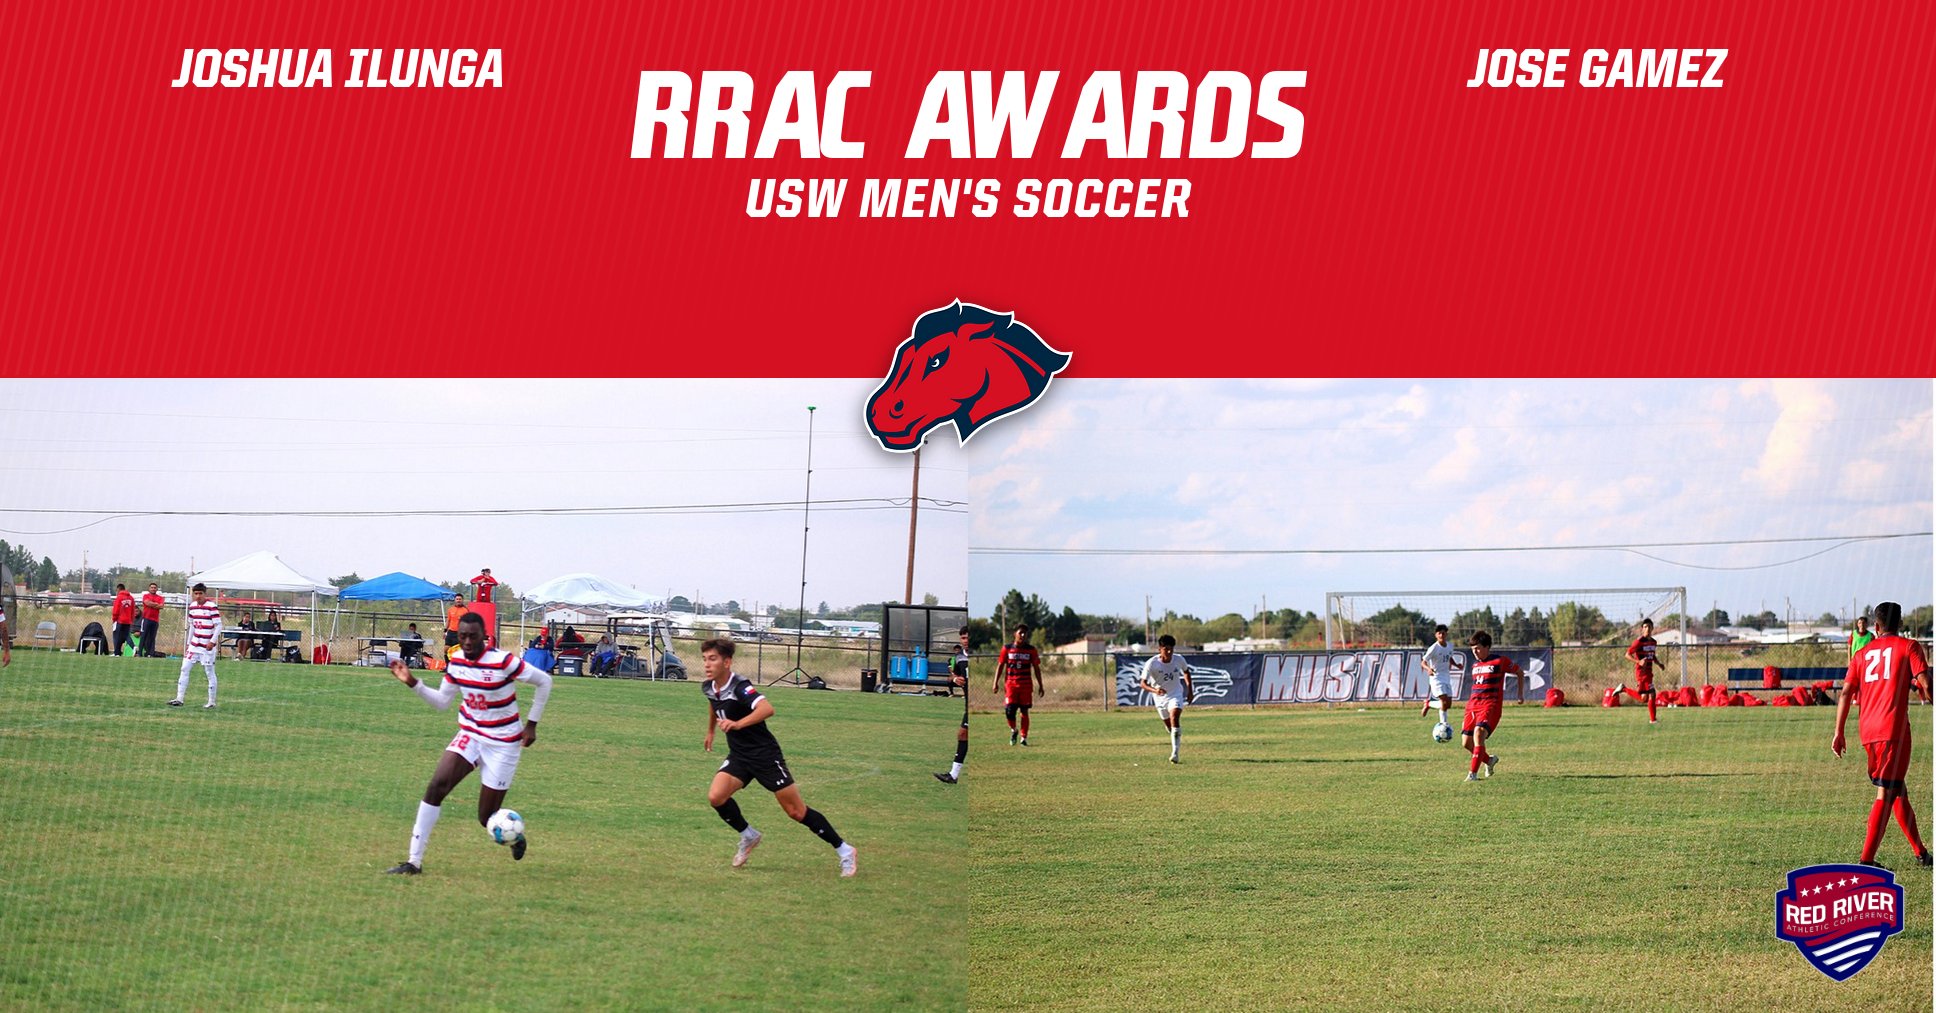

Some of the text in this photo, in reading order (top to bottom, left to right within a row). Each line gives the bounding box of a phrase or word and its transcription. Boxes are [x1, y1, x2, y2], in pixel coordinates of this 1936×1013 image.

[1864, 646, 1892, 683] 21
[1164, 672, 1174, 681] 24
[468, 693, 488, 711] 22
